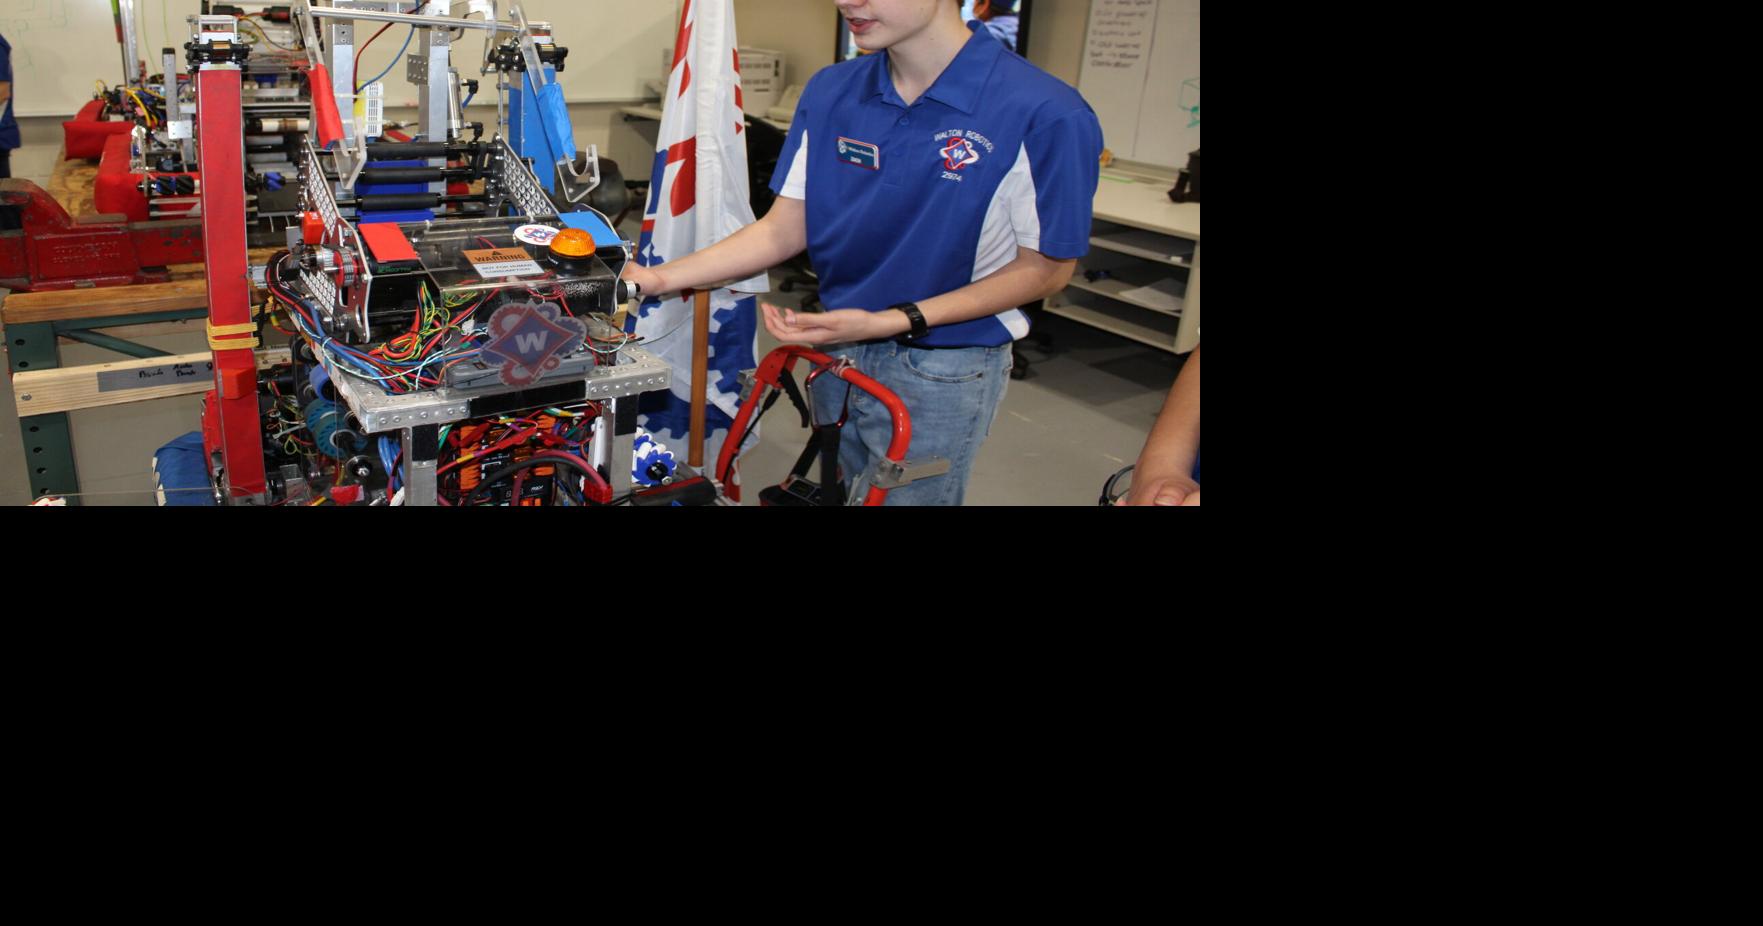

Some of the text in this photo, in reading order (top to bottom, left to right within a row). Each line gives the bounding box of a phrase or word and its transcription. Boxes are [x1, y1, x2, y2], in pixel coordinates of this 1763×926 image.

[934, 129, 963, 141] WALTON
[953, 149, 966, 159] W
[474, 254, 525, 262] WARNING
[515, 330, 549, 355] W
